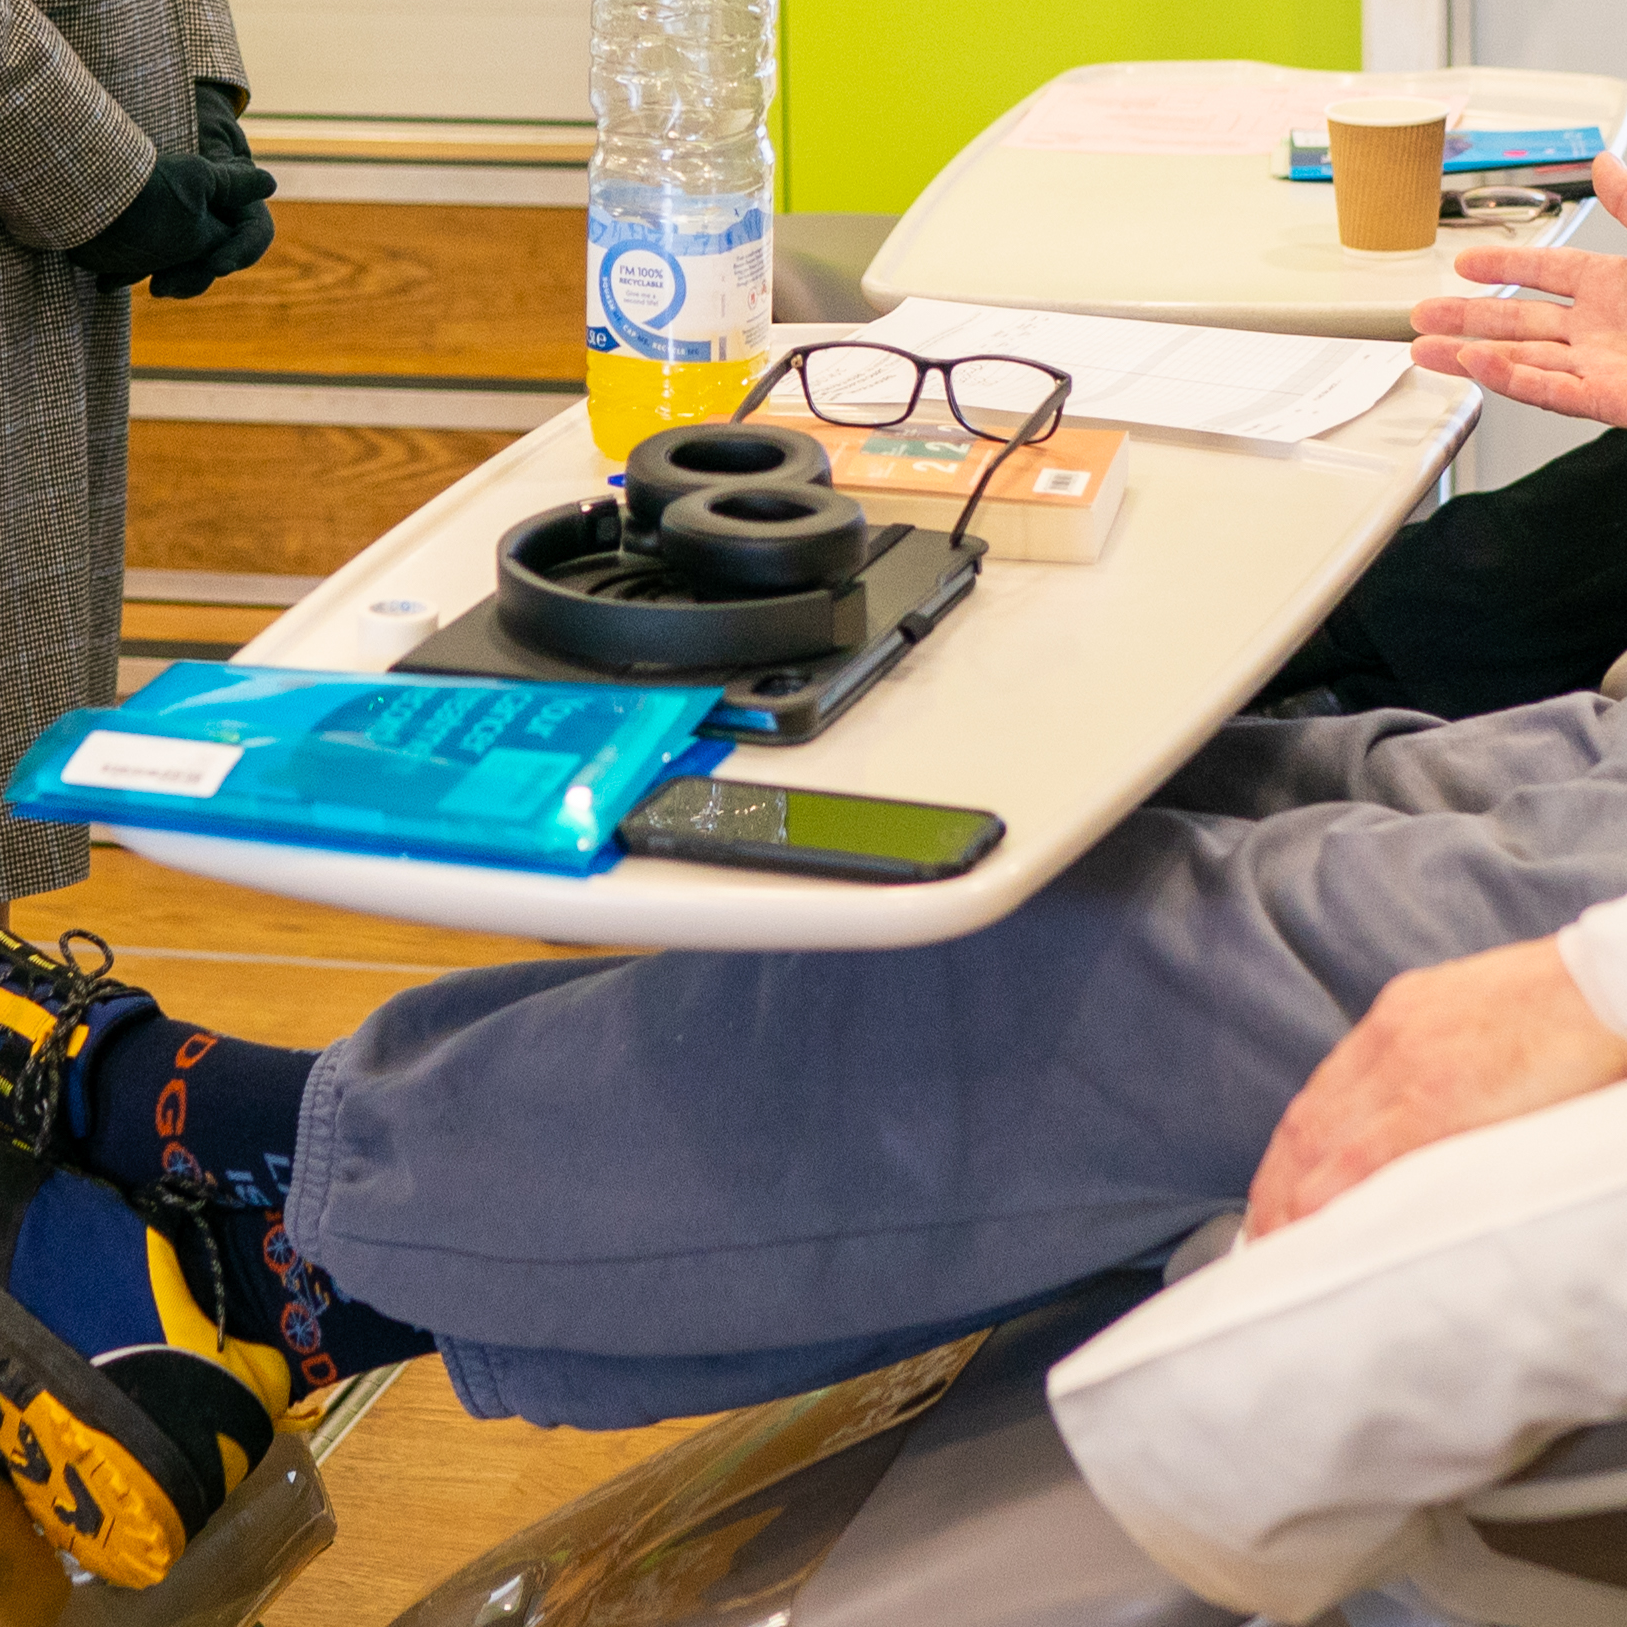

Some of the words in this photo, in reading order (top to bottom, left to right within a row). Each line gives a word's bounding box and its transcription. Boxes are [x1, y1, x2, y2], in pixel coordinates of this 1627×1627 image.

[619, 265, 635, 276] I'M
[638, 266, 664, 279] 100%
[619, 277, 663, 289] RECYCLABLE
[623, 324, 636, 337] CAP
